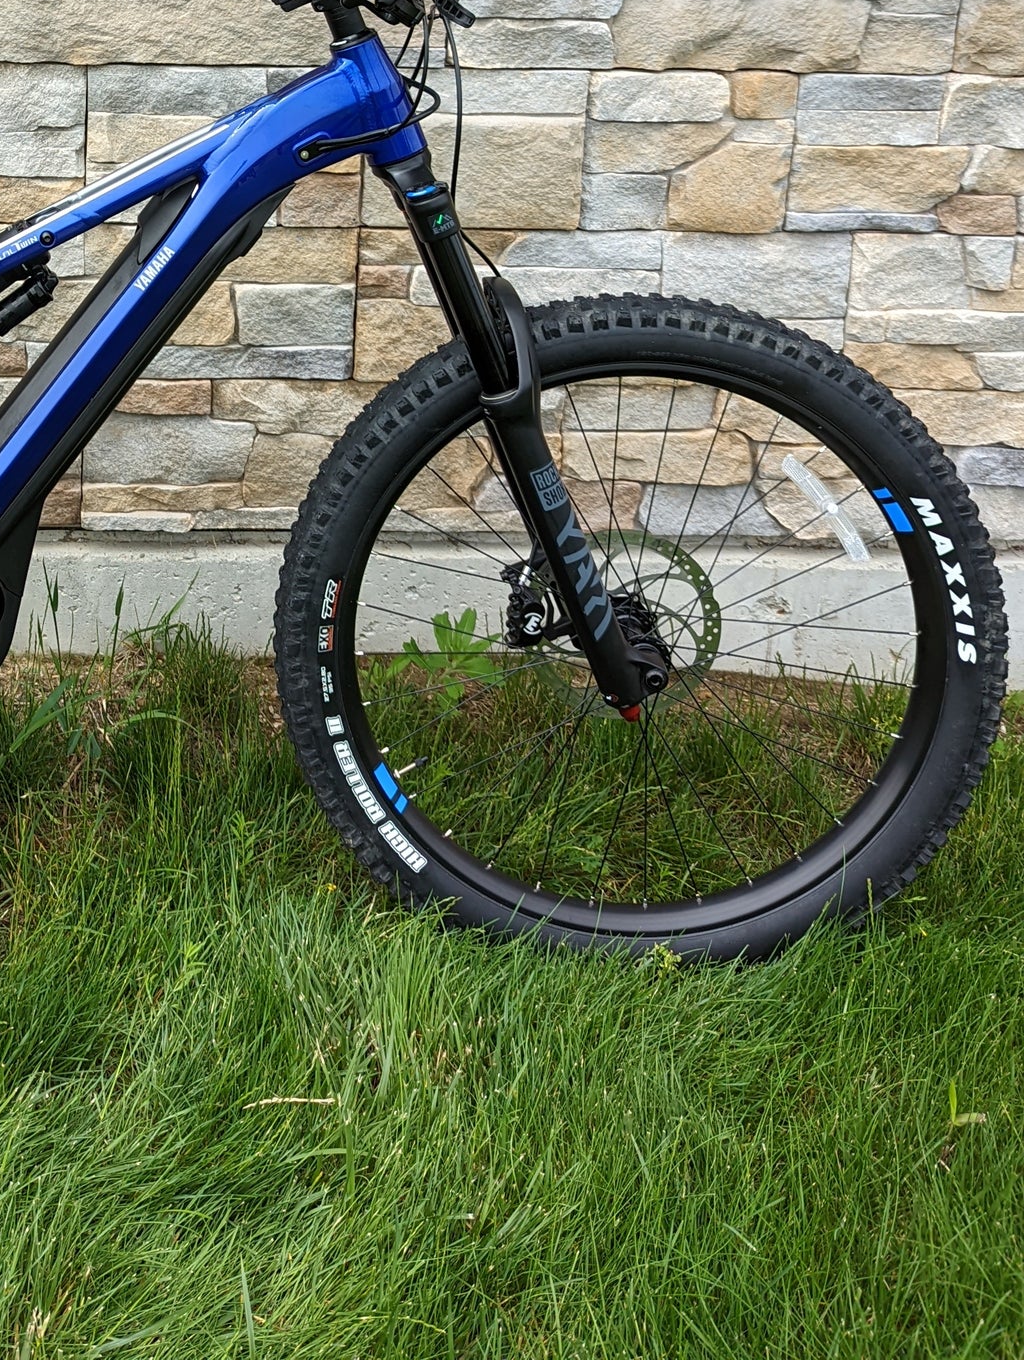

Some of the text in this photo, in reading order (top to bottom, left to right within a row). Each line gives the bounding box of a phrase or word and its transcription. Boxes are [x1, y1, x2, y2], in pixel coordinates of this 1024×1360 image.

[134, 245, 175, 291] YAMAHA
[535, 465, 560, 490] ROC
[543, 485, 568, 507] SHO
[909, 496, 977, 665] MAXXIS
[319, 626, 330, 651] EXO
[333, 740, 386, 824] ROLLER
[378, 820, 428, 873] HIGH
